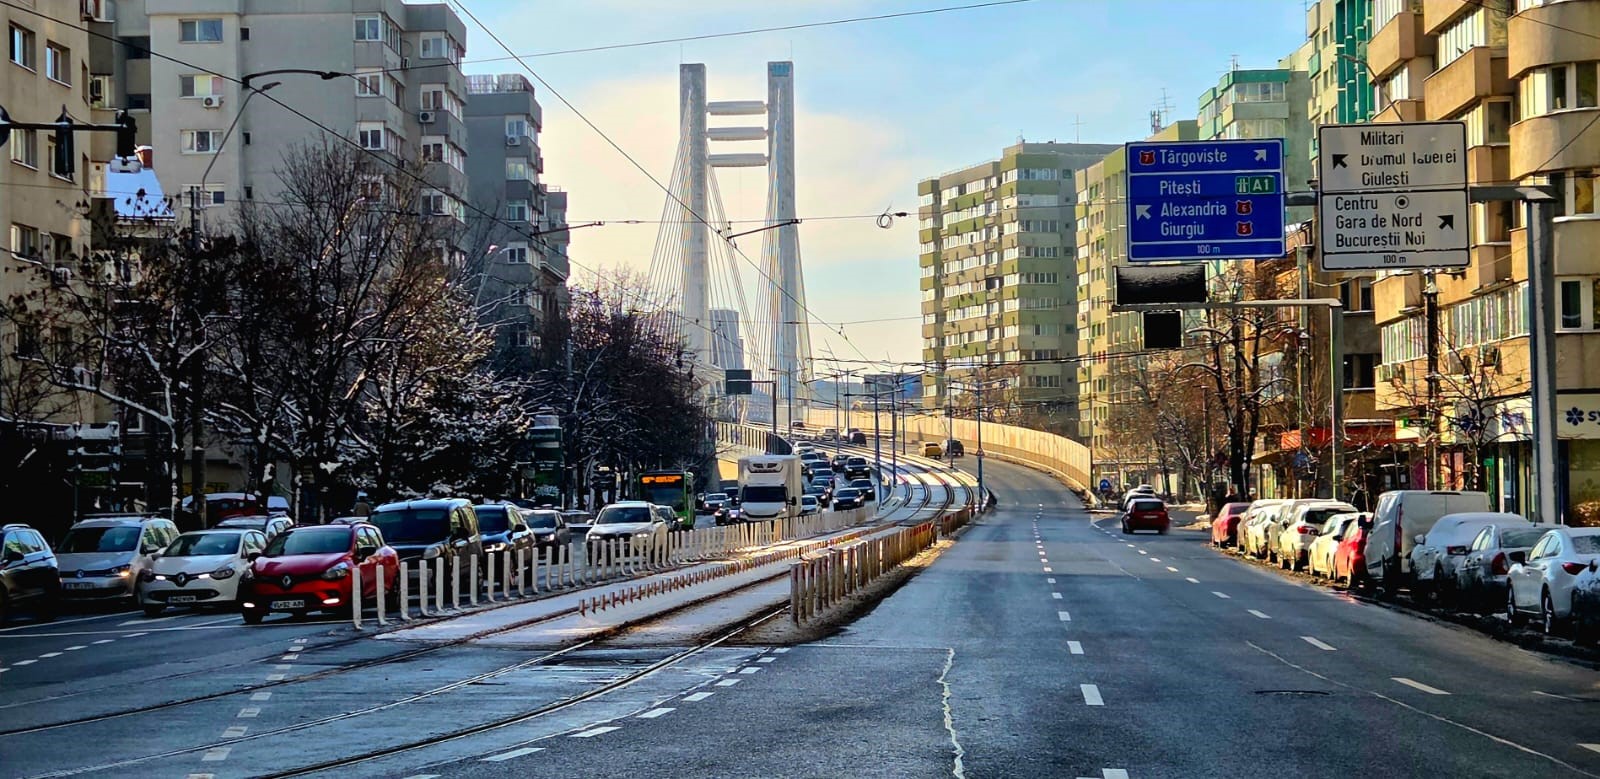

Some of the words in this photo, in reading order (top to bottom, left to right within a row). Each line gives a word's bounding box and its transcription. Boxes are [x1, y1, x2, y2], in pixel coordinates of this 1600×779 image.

[1361, 131, 1404, 145] Militari
[1160, 180, 1201, 197] Pitești
[1252, 179, 1270, 191] A1
[1160, 201, 1227, 217] Alexandria
[1335, 196, 1378, 211] Centru
[1335, 215, 1366, 229] Gara
[1371, 214, 1387, 228] de
[1392, 212, 1422, 227] Nord
[1160, 220, 1205, 239] Giurgiu
[1336, 232, 1400, 249] Bucureștii
[1405, 231, 1425, 245] Noi
[1197, 245, 1211, 254] 100
[1212, 246, 1221, 254] m
[1383, 255, 1397, 264] 100
[1398, 256, 1407, 264] m
